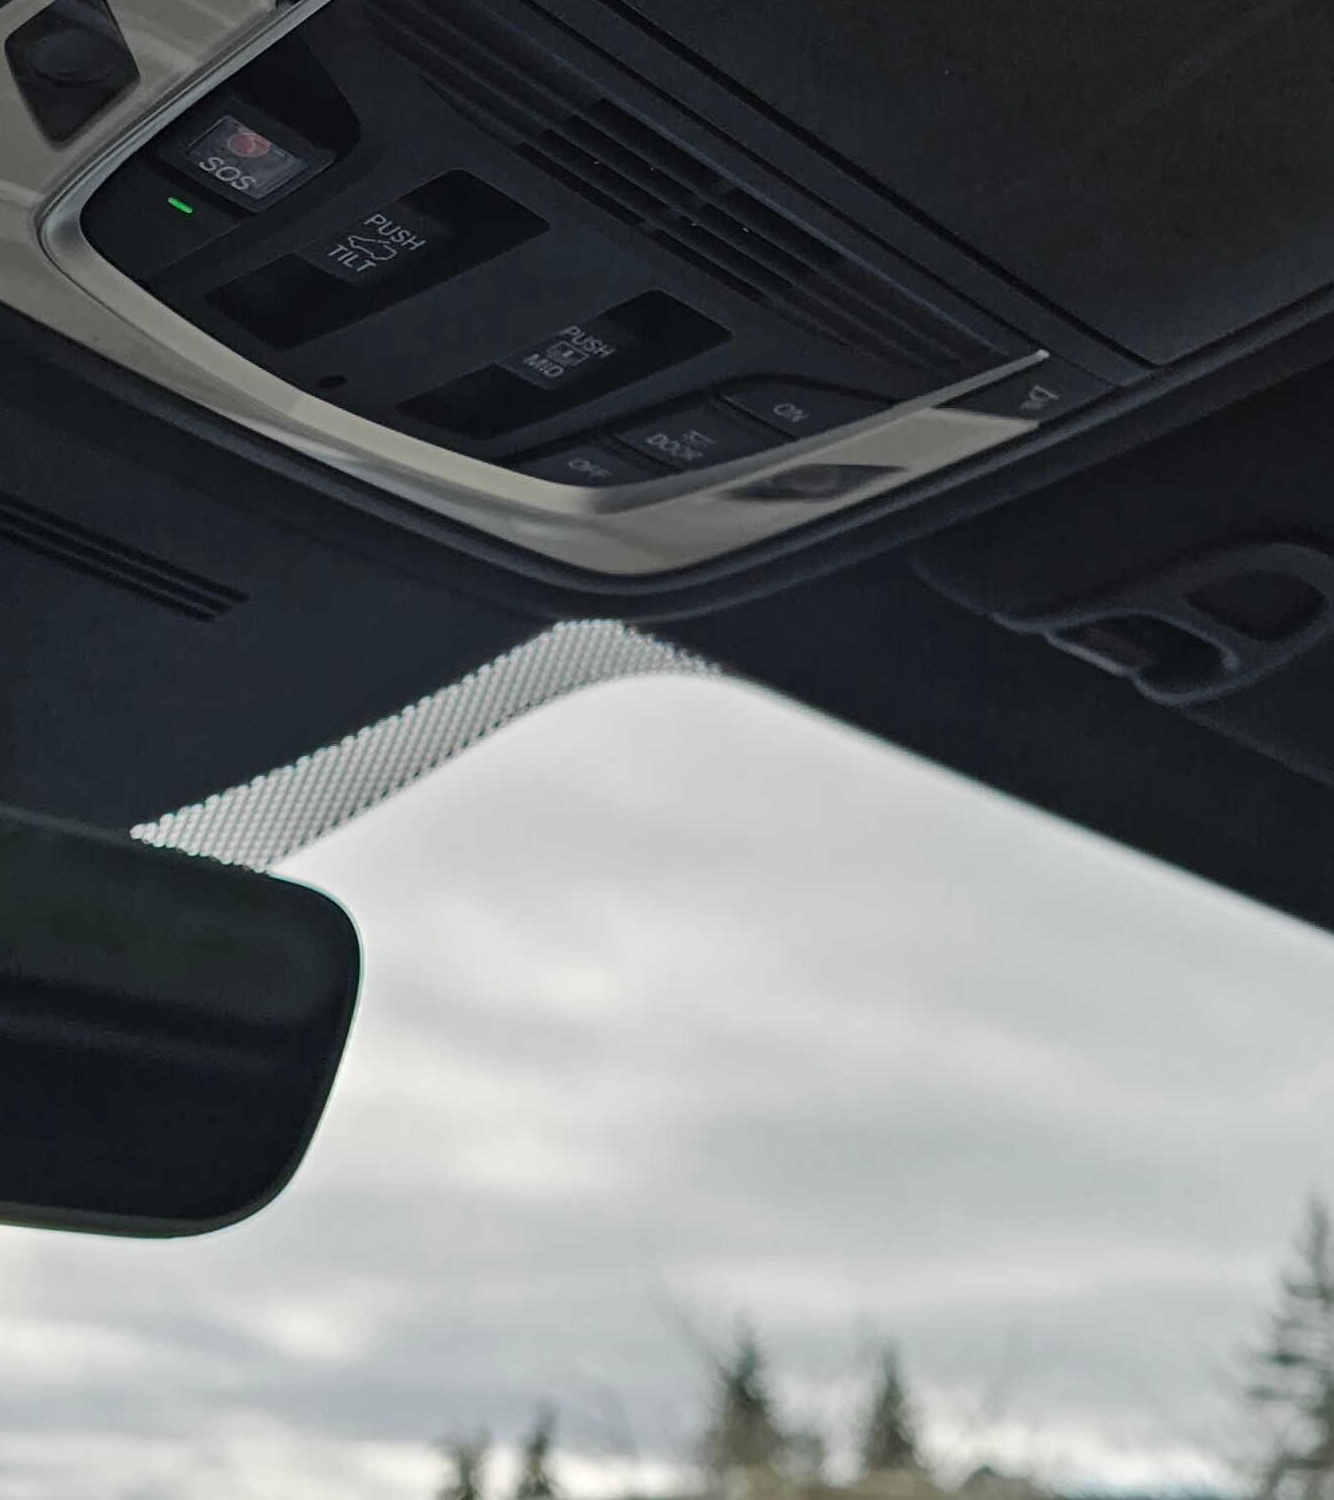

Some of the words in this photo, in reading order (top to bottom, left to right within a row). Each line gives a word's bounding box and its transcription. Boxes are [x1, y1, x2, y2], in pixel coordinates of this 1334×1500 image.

[198, 156, 257, 190] SOS
[362, 213, 427, 252] PUSH
[327, 243, 378, 272] TILT
[557, 325, 617, 360] PUSH
[523, 353, 564, 378] MID
[773, 402, 810, 423] ON
[567, 457, 613, 479] OFF
